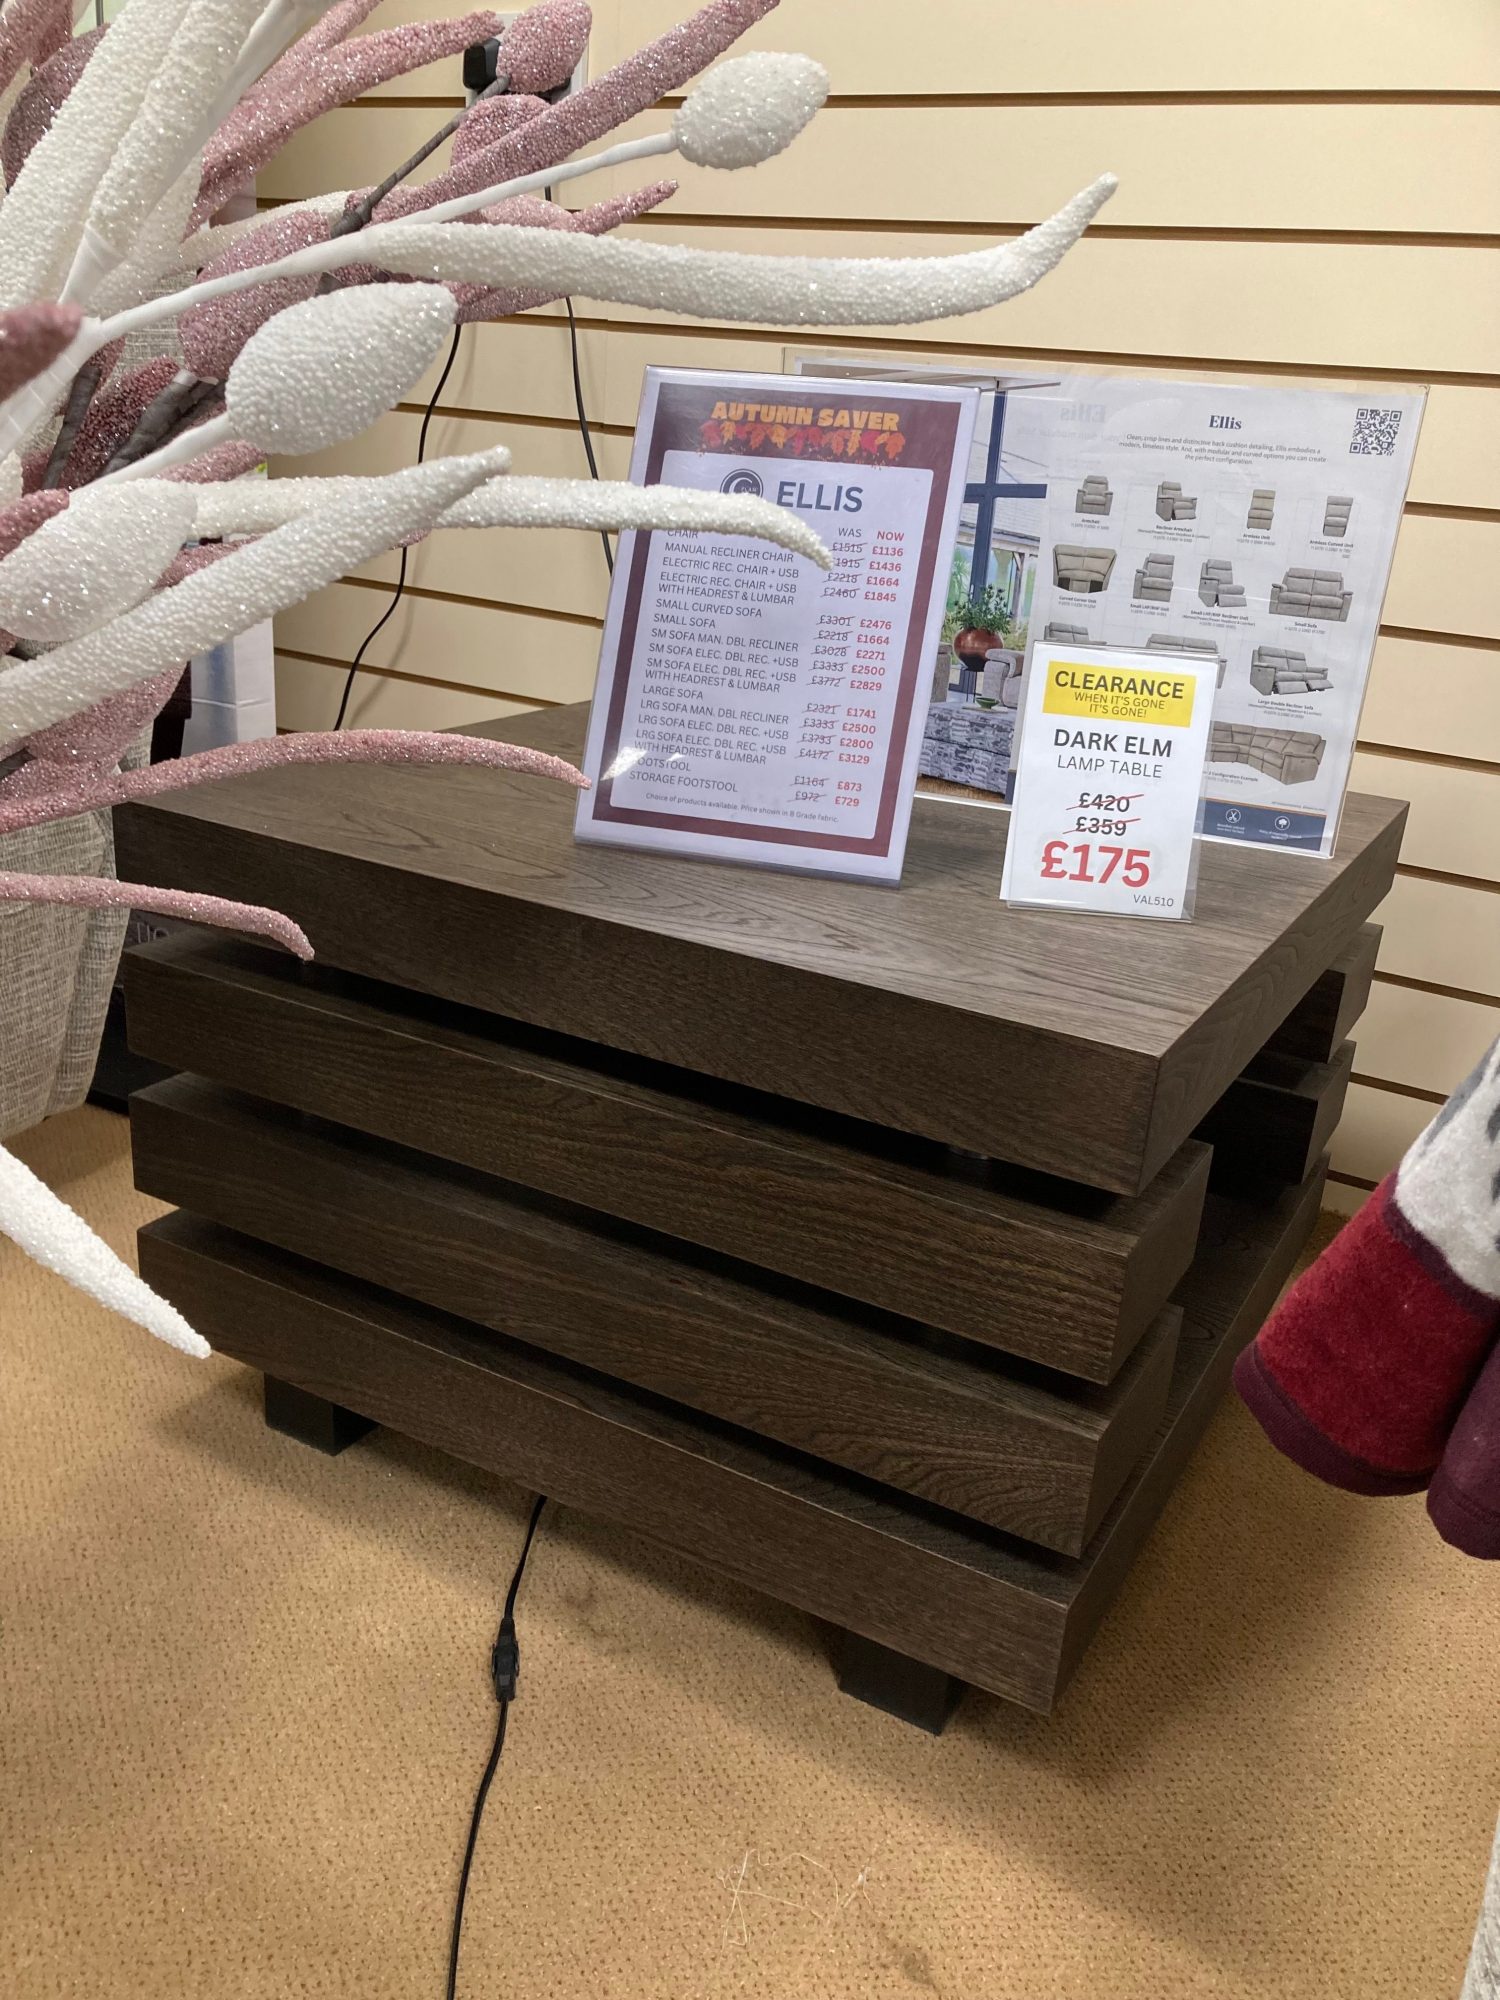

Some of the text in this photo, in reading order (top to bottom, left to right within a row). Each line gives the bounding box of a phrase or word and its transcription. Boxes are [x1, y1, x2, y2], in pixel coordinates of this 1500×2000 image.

[711, 401, 900, 431] AUTUMN SAVER
[1209, 415, 1242, 429] Ellis
[776, 481, 864, 513] ELLIS
[668, 530, 698, 539] CHAIR
[839, 528, 904, 541] WAS NOW
[665, 543, 793, 562] MANUAL RECLINER CHAIR
[832, 543, 903, 556] £1515 £1136
[663, 557, 710, 570] ELECTRIC
[713, 563, 733, 572] REC.
[737, 564, 768, 575] CHAIR
[779, 568, 799, 578] USB
[833, 558, 901, 572] 1915 £1436
[661, 572, 708, 584] ELECTRIC
[710, 578, 731, 587] REC.
[735, 579, 765, 590] CHAIR
[776, 583, 796, 593] USB
[828, 573, 899, 587] £2218 £1664
[659, 584, 794, 605] WITH HEADREST & LUMBAR
[824, 588, 896, 602] £2460 £1845
[656, 599, 762, 617] SMALL CURVED SOFA
[654, 614, 716, 628] SMALL SOFA
[860, 619, 892, 630] £2476
[651, 628, 798, 652] SM SOFA MAN. DBL RECLINER
[819, 630, 889, 645] £2218 £1664
[649, 643, 664, 653] SM
[667, 645, 693, 656] SOFA
[696, 648, 722, 659] ELEC.
[725, 651, 745, 662] DBL
[748, 654, 770, 665] REC.
[815, 645, 885, 660] £3028 £2271
[647, 658, 662, 668] SM
[664, 660, 690, 671] SOFA
[693, 663, 720, 674] ELEC.
[723, 666, 742, 676] DBL
[745, 668, 767, 679] REC.
[851, 665, 885, 676] £2500
[645, 669, 780, 693] WITH HEADREST & LUMBAR
[850, 680, 882, 691] £2829
[1055, 670, 1184, 699] CLEARANCE
[643, 685, 703, 699] LARGE SOFA
[1075, 692, 1165, 709] WHEN IT'S GONE
[641, 699, 788, 724] LRG SOFA MAN. DBL RECLINER
[847, 708, 876, 719] £1741
[1089, 704, 1147, 718] IT'S GONE!
[639, 714, 657, 725] LRG
[659, 717, 685, 728] SOFA
[688, 720, 714, 731] ELEC.
[717, 723, 736, 734] DBL
[739, 726, 760, 737] REC.
[842, 723, 876, 734] £2500
[636, 729, 655, 740] LRG
[657, 732, 683, 743] SOFA
[686, 735, 710, 746] ELEC.
[714, 738, 734, 749] DBL
[737, 741, 757, 751] REC.
[840, 738, 873, 749] £2800
[1054, 729, 1172, 758] DARK ELM
[635, 741, 766, 765] WITH HEADREST & LUMBAR
[800, 748, 870, 764] £4172 £3129
[636, 756, 691, 772] OOTSTOOL
[1057, 755, 1163, 778] LAMP TABLE
[629, 771, 738, 793] STORAGE FOOTSTOOL
[794, 776, 861, 791] £1164 £873
[646, 792, 668, 800] Choice
[678, 798, 706, 806] products
[709, 801, 739, 810] available.
[796, 811, 816, 819] Grade
[795, 791, 859, 806] £972 £729
[1079, 793, 1130, 812] £420
[1076, 817, 1126, 836] £359
[1040, 840, 1150, 888] £175
[1133, 894, 1174, 906] VAL510
